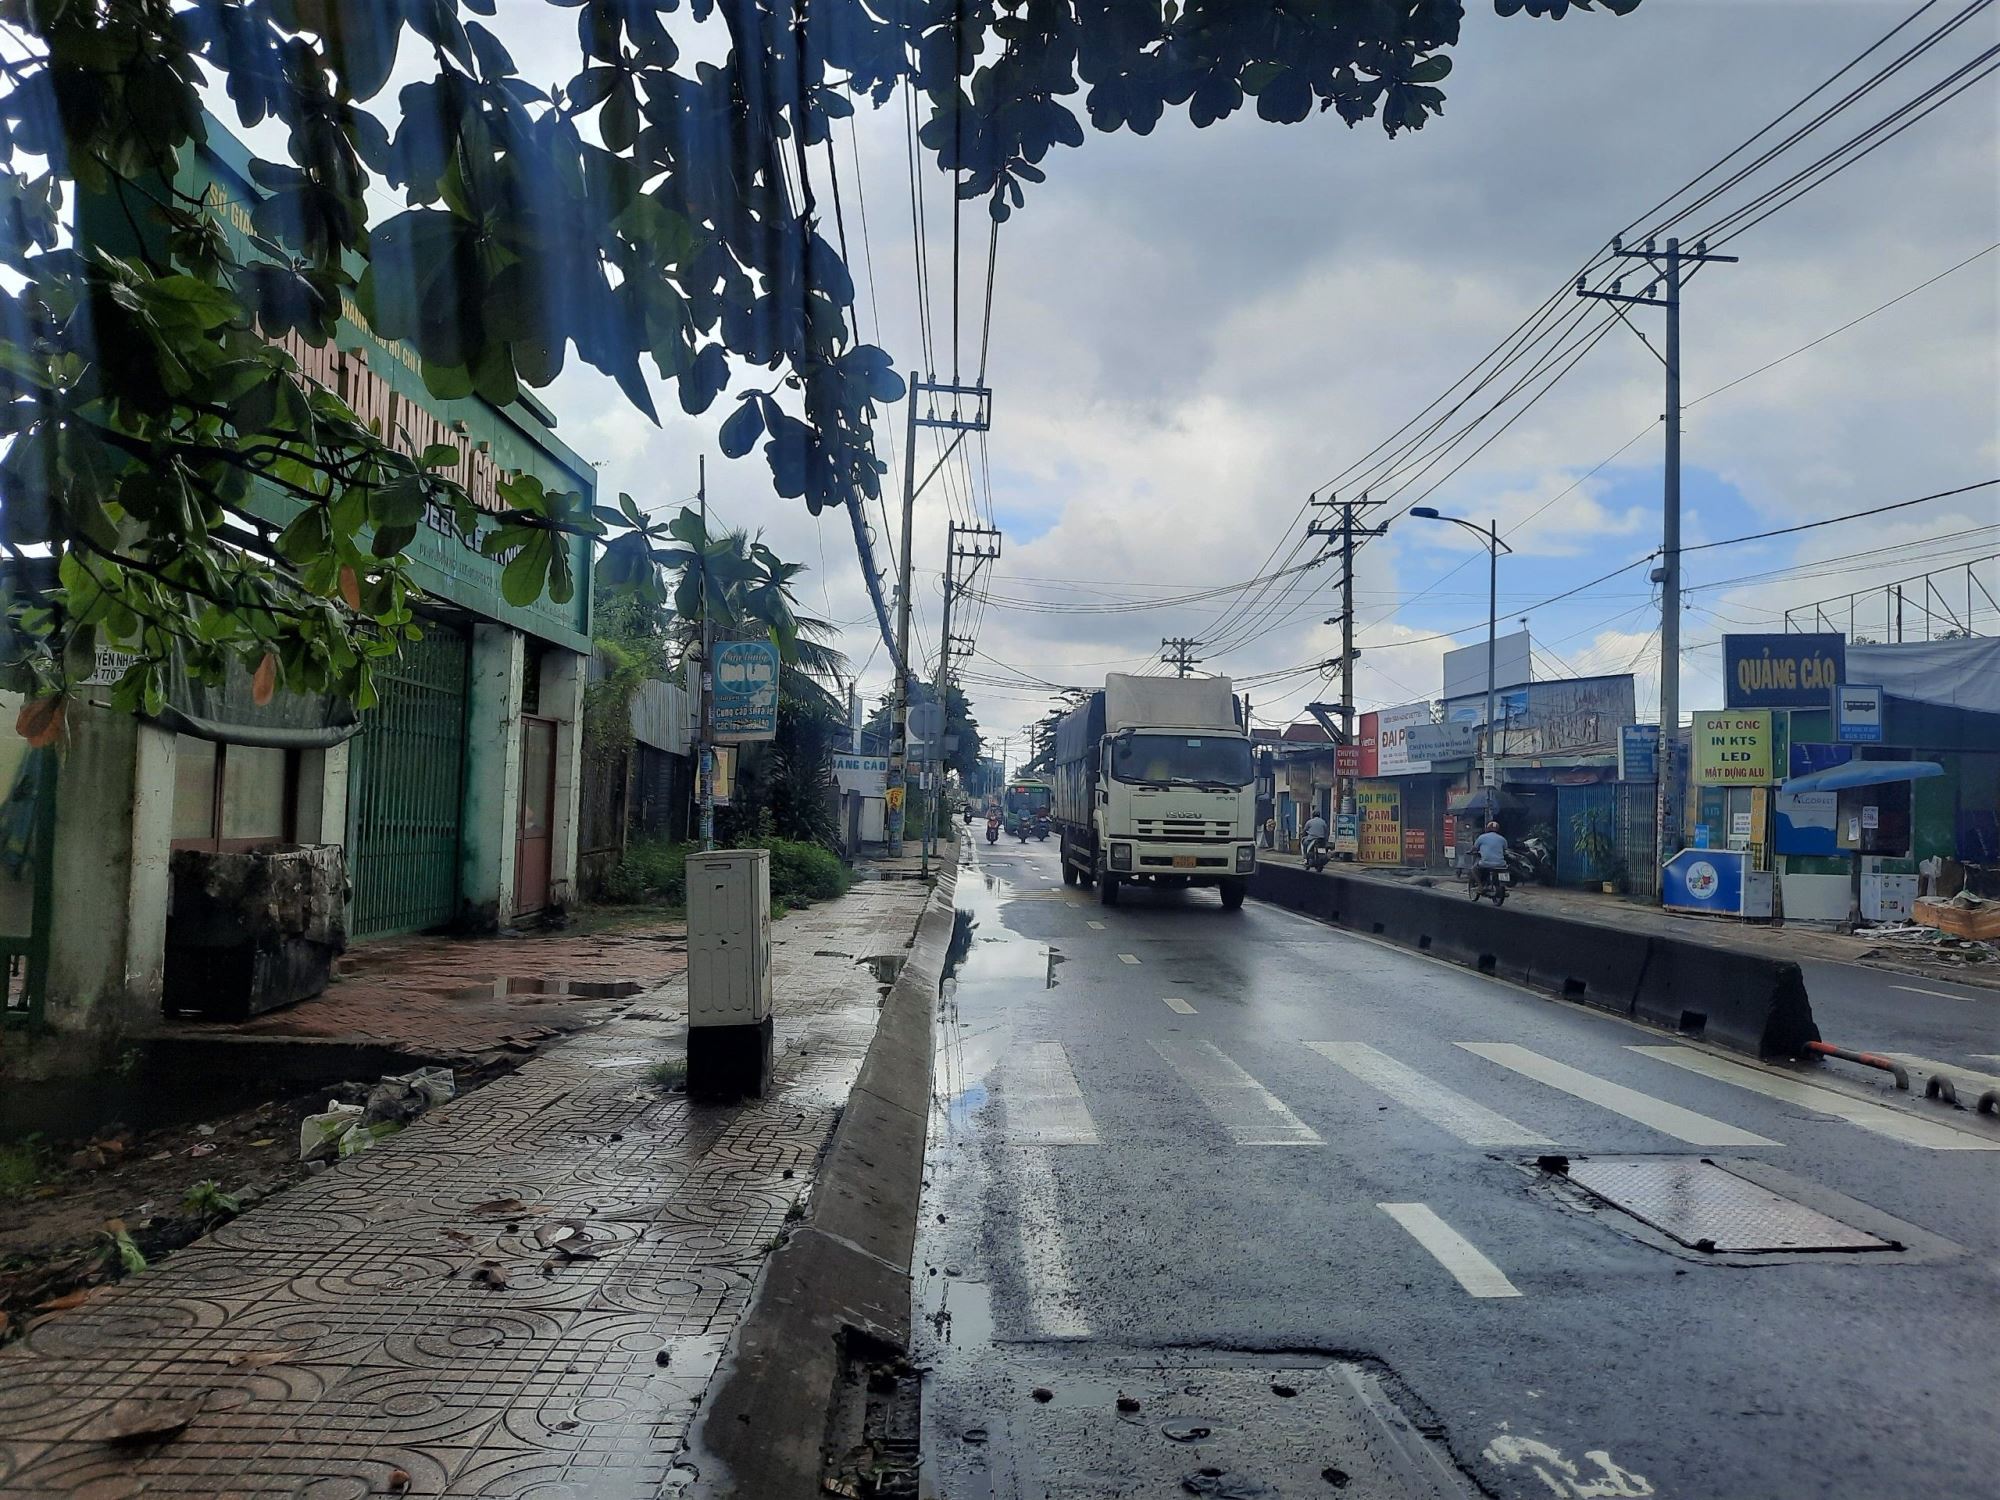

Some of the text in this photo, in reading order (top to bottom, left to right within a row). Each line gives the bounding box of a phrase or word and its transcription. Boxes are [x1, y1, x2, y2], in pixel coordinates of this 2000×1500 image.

[1738, 647, 1836, 695] QUẢNG CÁO
[1735, 720, 1761, 730] CNC
[1711, 736, 1757, 746] IN KTS
[1721, 752, 1751, 762] LED
[1748, 768, 1765, 778] ALU
[1166, 811, 1202, 819] ISUZU
